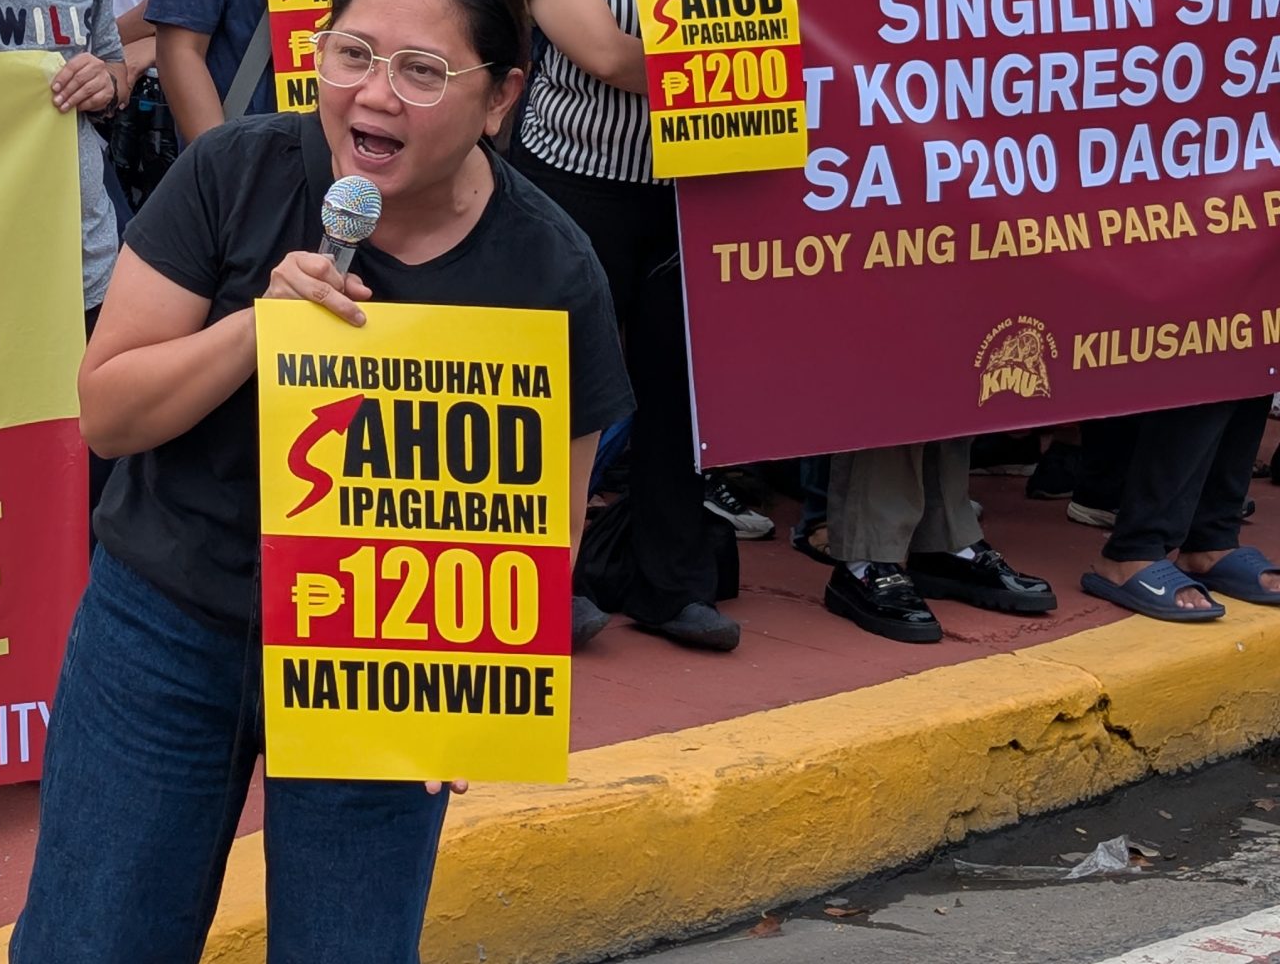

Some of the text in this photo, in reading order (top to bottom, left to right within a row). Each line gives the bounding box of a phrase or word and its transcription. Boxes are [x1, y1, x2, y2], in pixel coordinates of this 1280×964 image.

[681, 18, 788, 46] IPAGLABAN!
[803, 67, 834, 129] T
[855, 41, 1204, 127] KONGRESO
[660, 108, 798, 143] NATIONWIDE
[803, 111, 1280, 211] SA P200 DAGDA
[713, 233, 851, 282] TULOY
[864, 225, 955, 270] ANG
[969, 212, 1090, 261] LABAN
[1098, 202, 1198, 246] PARA
[1204, 194, 1256, 234] SA
[974, 318, 1012, 368] KILUSANG
[1018, 315, 1045, 331] MAYO
[1073, 313, 1253, 370] KILUSANG
[277, 353, 552, 398] NAKABUBUHAY NA
[981, 367, 1038, 401] KMU
[339, 486, 548, 535] IPAGLABAN!
[282, 657, 555, 717] NATIONWIDE
